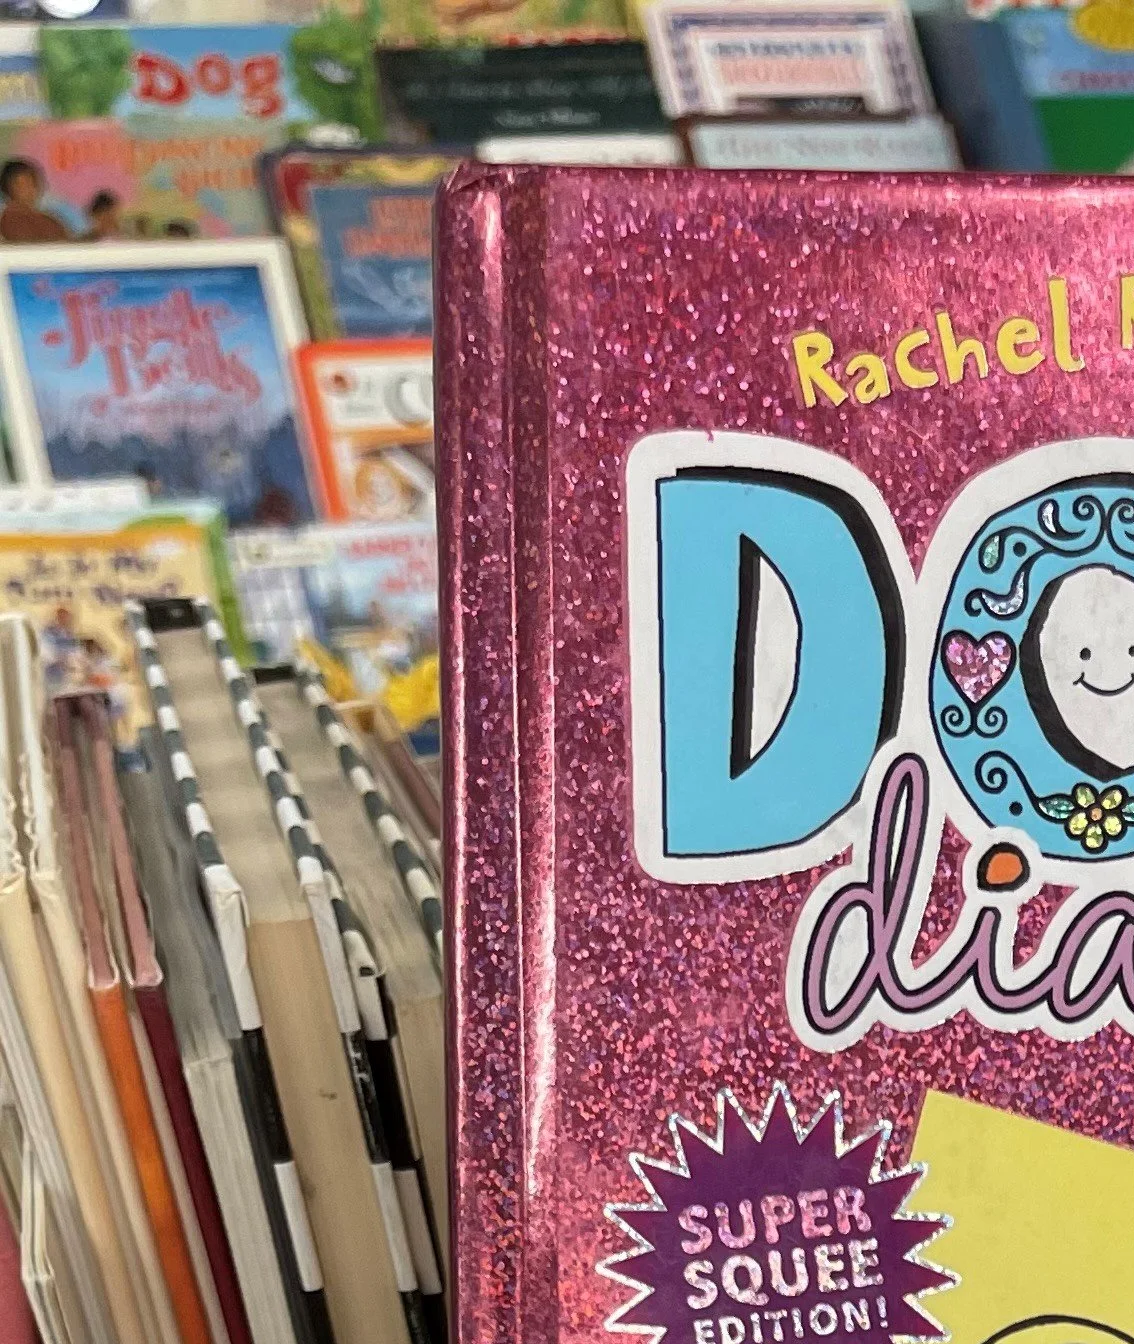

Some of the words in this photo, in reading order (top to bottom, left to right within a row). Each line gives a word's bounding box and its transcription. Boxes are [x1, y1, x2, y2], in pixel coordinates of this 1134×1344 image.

[130, 51, 286, 119] Dog
[792, 276, 1086, 409] Rachel
[678, 1186, 872, 1254] SUPER
[683, 1238, 884, 1309] SQUEE
